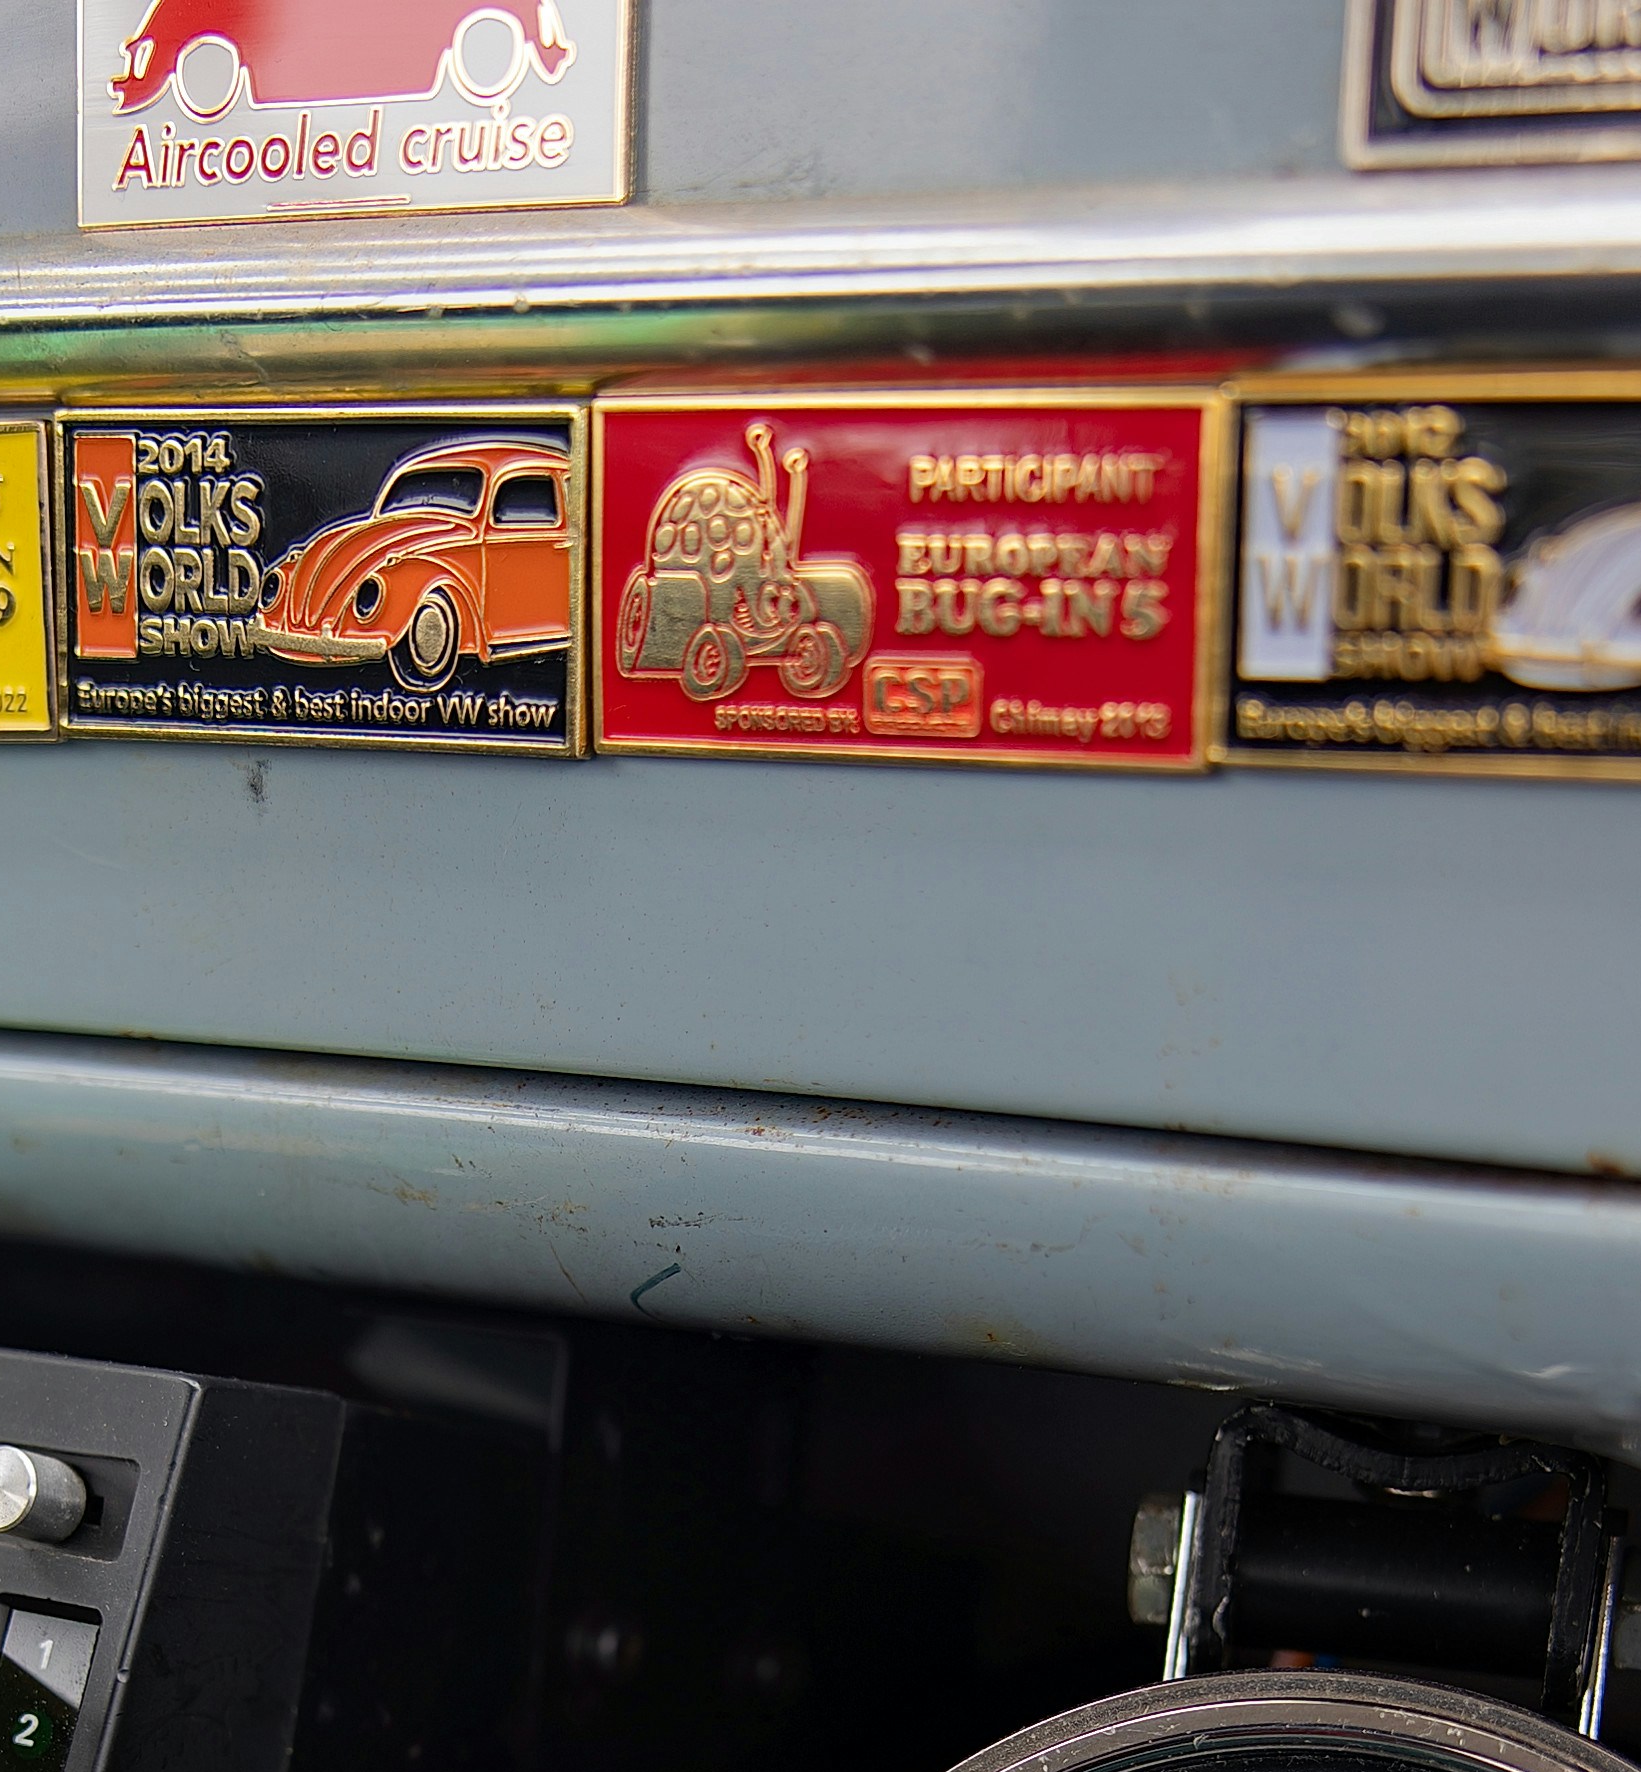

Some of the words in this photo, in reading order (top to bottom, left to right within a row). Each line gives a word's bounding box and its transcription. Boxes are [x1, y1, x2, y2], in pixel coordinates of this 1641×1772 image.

[112, 105, 384, 191] Aircooled
[399, 101, 573, 172] cruise
[137, 432, 231, 474] 2014
[909, 451, 1164, 504] PARTICIPANT
[897, 530, 1172, 579] EUROPEAN
[896, 576, 1119, 638] BUG-IN
[1122, 579, 1170, 640] 5
[140, 615, 260, 658] SHOW
[77, 682, 173, 717] Europe's
[178, 684, 264, 724] biggest
[271, 687, 293, 717] &
[296, 686, 346, 721] best
[350, 688, 430, 724] indoor
[438, 692, 484, 725] VW
[487, 691, 559, 729] show
[875, 669, 970, 714] CSP
[39, 1639, 54, 1670] 1
[12, 1713, 40, 1747] 2
